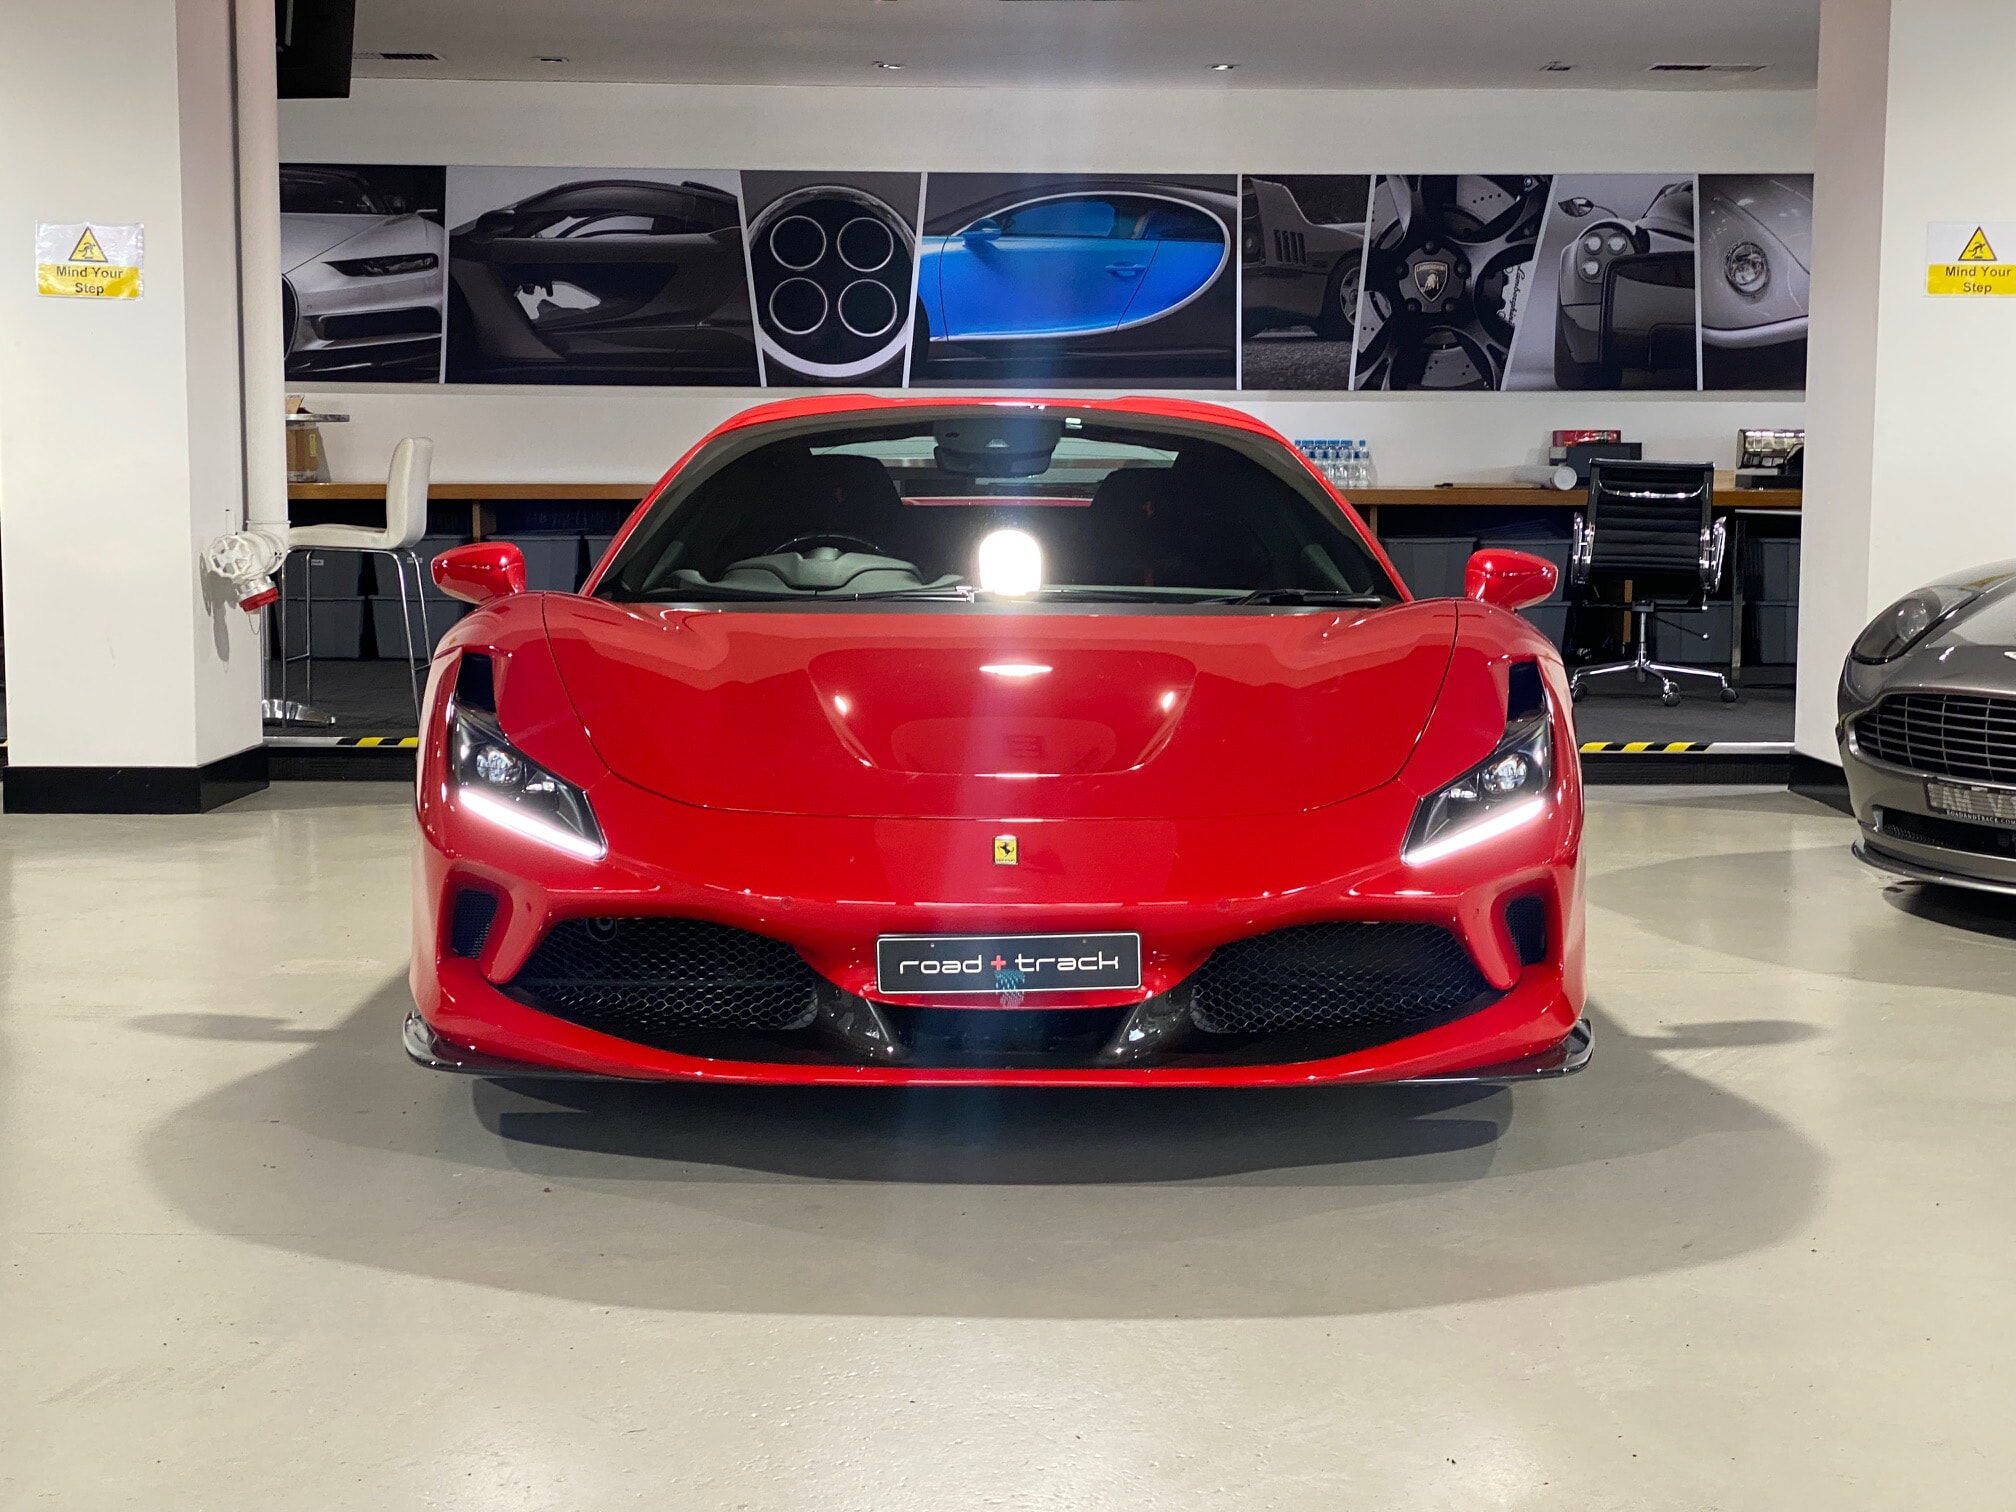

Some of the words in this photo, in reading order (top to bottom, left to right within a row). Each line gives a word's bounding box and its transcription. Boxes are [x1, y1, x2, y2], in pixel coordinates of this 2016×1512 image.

[56, 265, 88, 277] Mind
[92, 267, 124, 279] Your
[1945, 266, 1977, 277] Mind
[1981, 266, 2012, 277] Your
[74, 282, 104, 296] Step
[1963, 281, 1992, 295] Step
[899, 954, 982, 975] road
[1015, 951, 1119, 972] track
